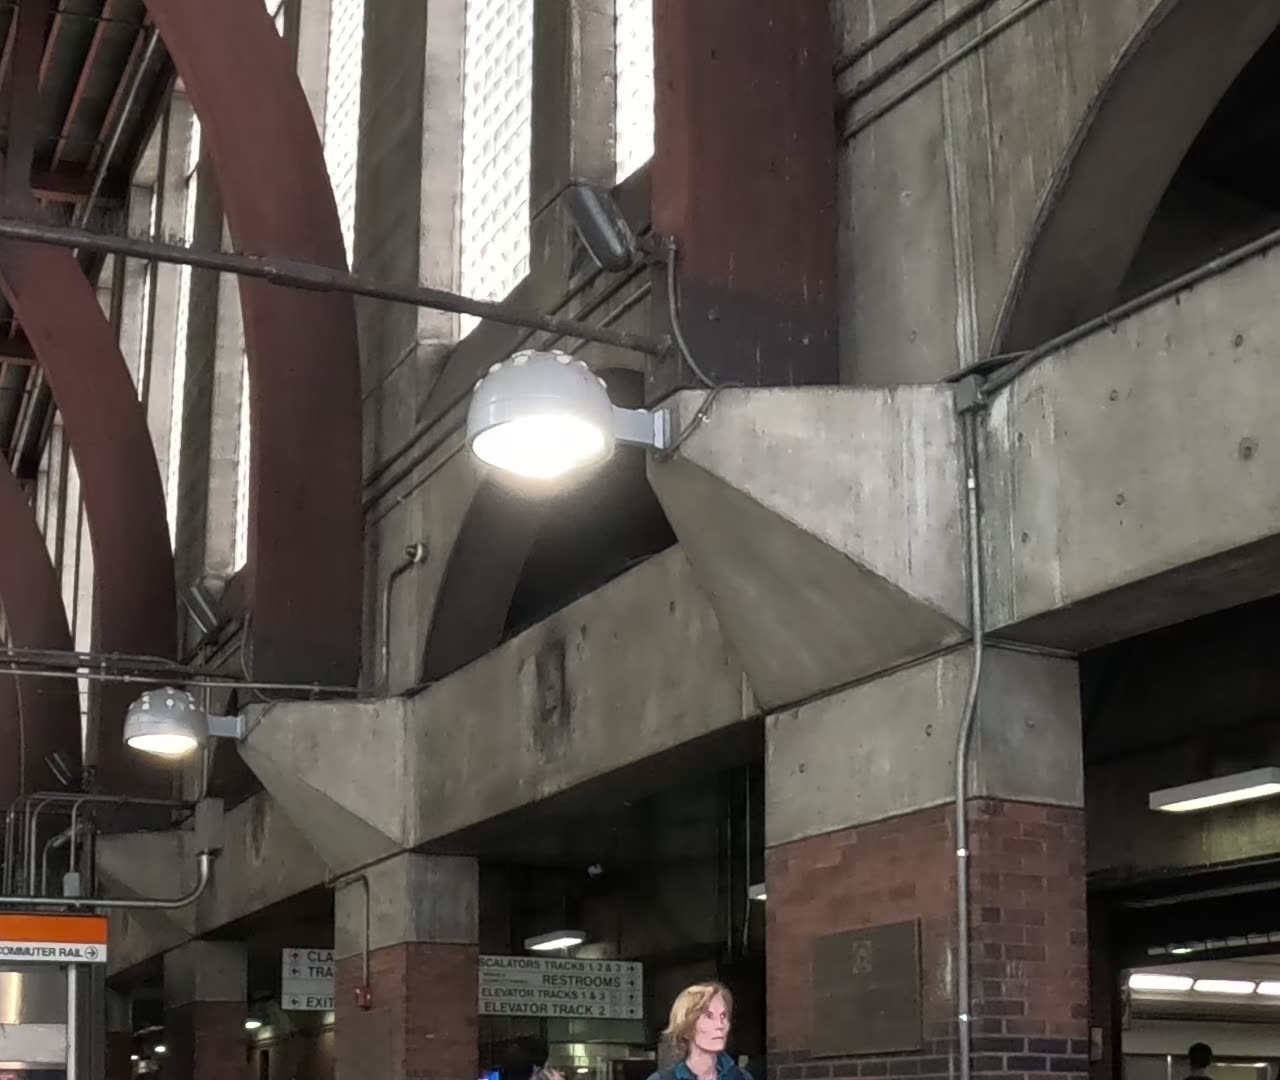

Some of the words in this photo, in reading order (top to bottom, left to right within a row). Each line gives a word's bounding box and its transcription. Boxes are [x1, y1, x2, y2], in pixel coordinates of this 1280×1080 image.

[58, 947, 84, 957] RAIL
[543, 960, 585, 971] TRACKS
[597, 963, 603, 972] 2
[605, 963, 612, 972] &
[615, 963, 621, 972] 3
[542, 974, 621, 987] RESTROOMS
[481, 987, 535, 998] ELEVATOR
[537, 989, 578, 999] TRACKS
[589, 991, 596, 1000] &
[599, 991, 605, 1000] 3
[484, 1001, 548, 1014] ELEVATOR
[552, 1004, 593, 1015] TRACK
[598, 1005, 606, 1016] 2
